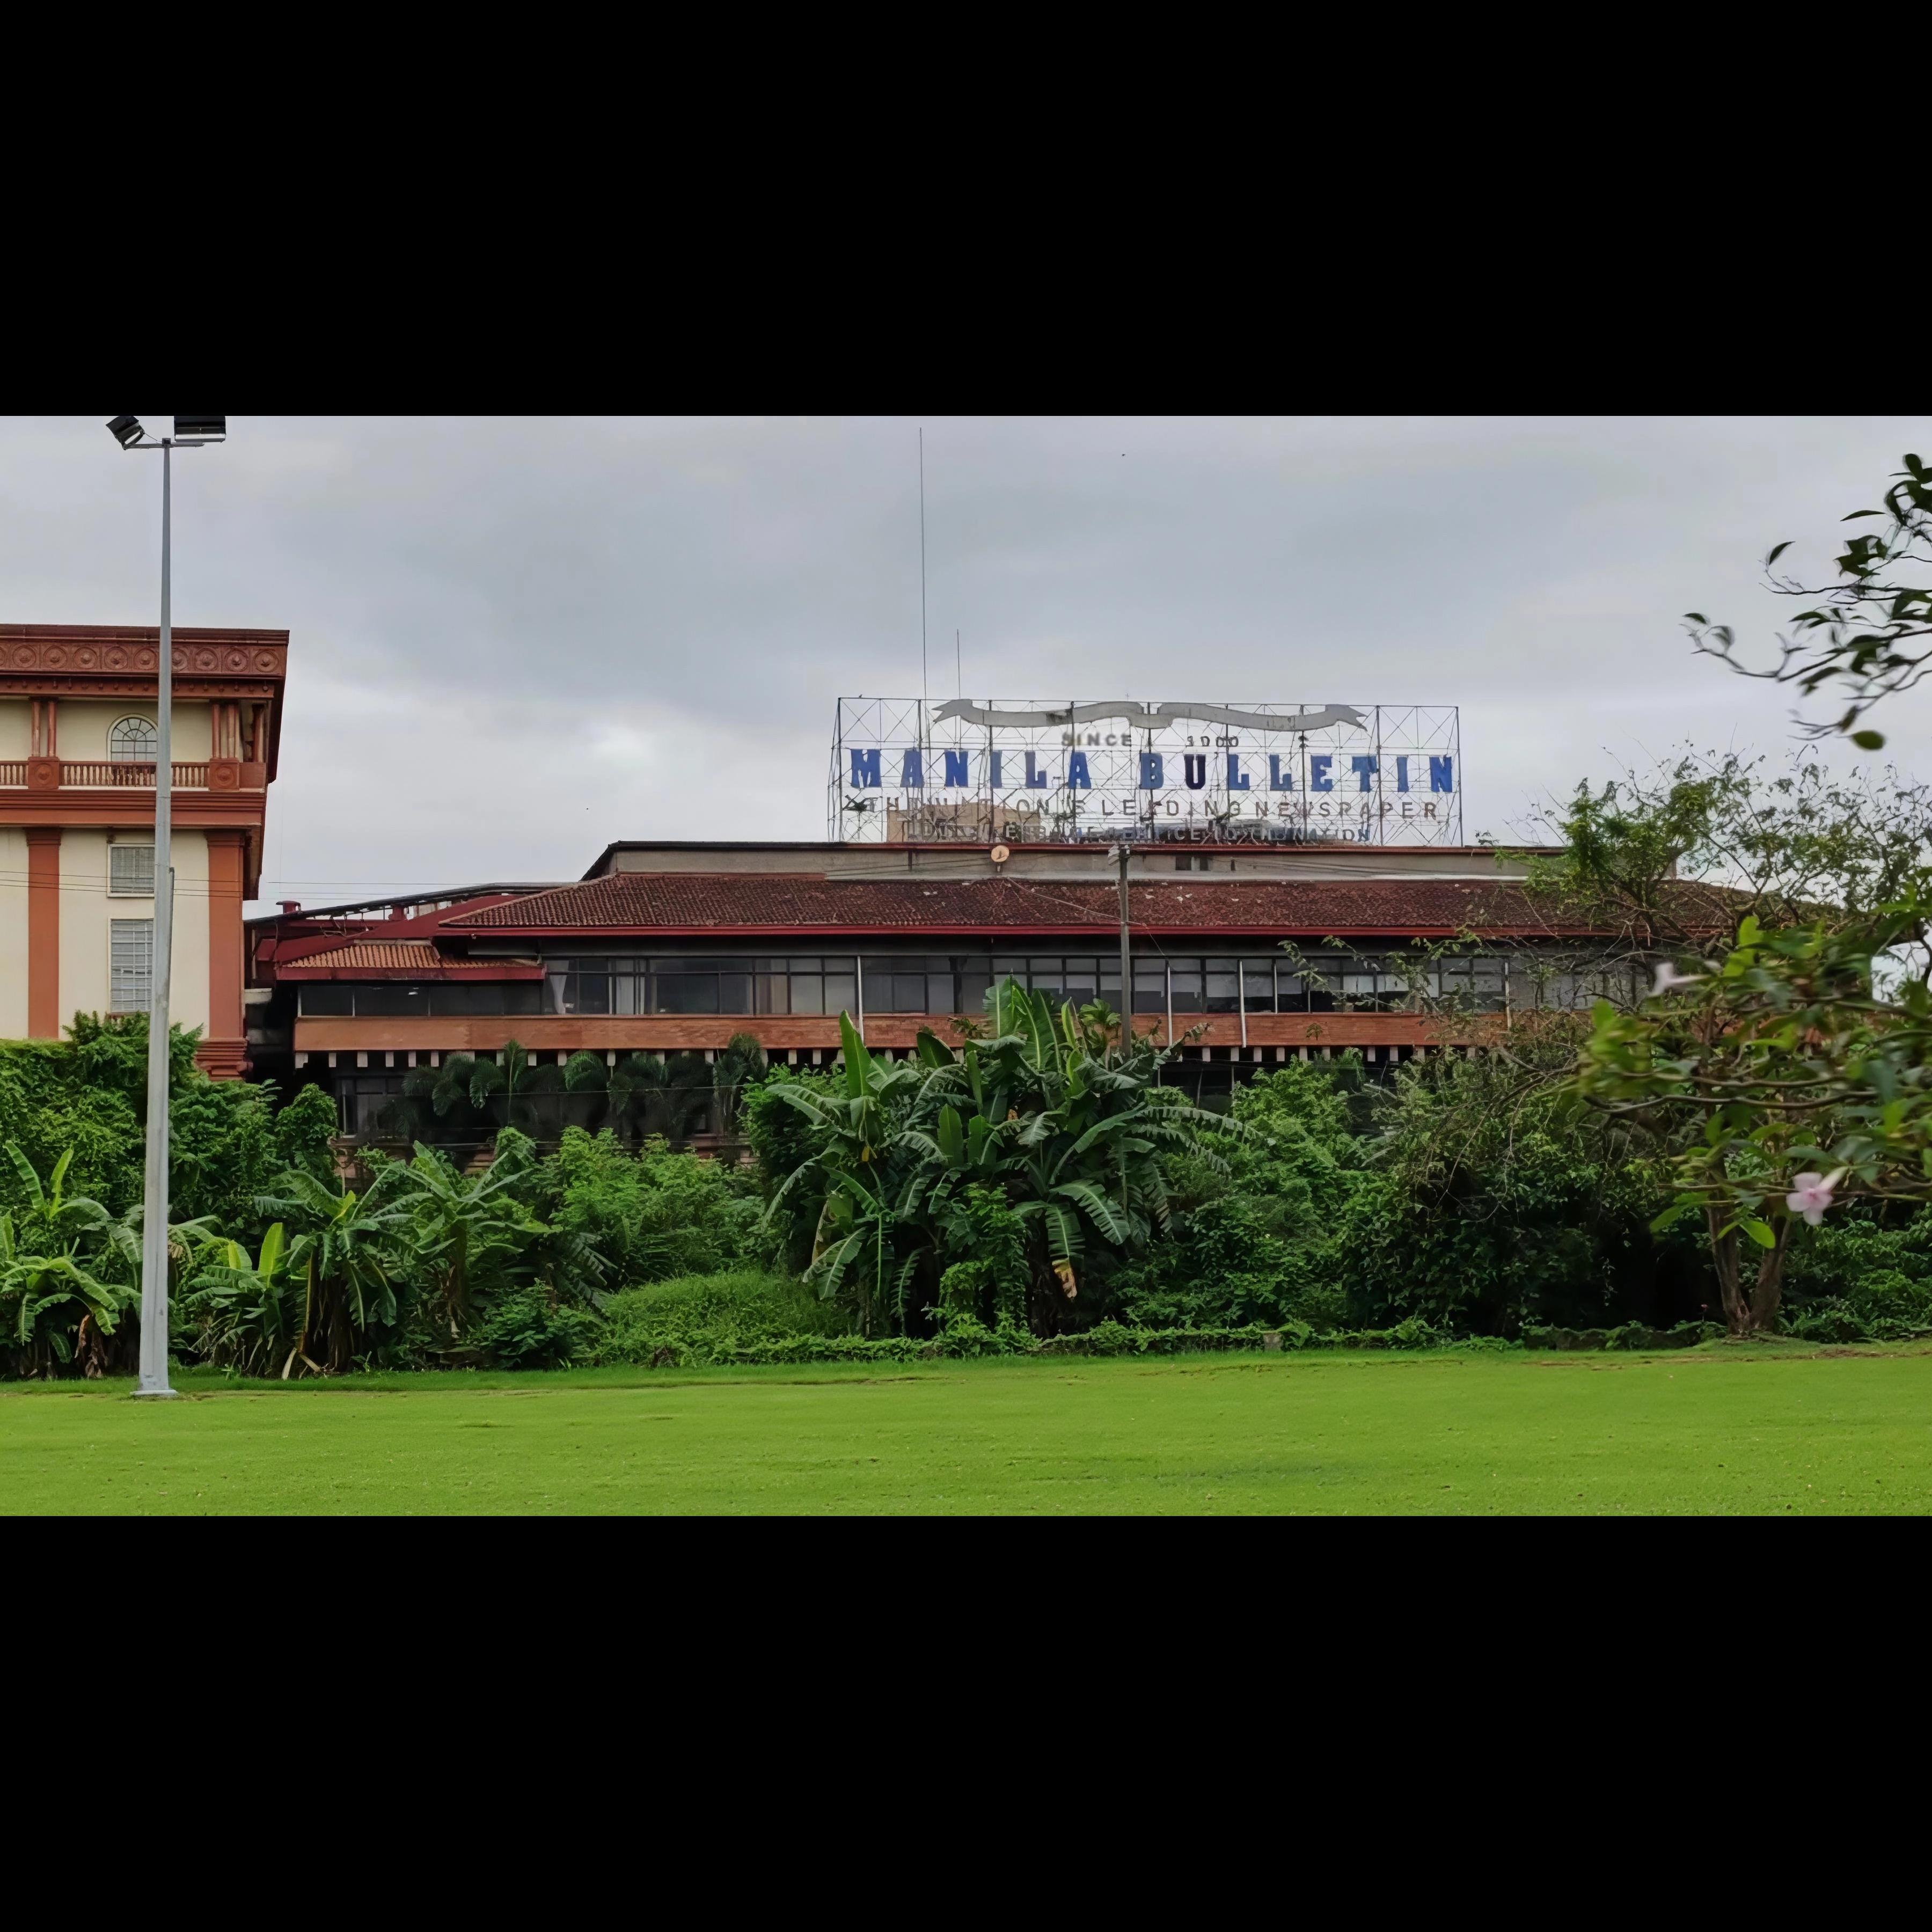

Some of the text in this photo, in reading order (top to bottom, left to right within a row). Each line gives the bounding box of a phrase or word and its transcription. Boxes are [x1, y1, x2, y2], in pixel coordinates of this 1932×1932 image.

[1062, 732, 1132, 747] SINCE
[851, 748, 1453, 793] MANILA BULLETIN
[1102, 799, 1241, 817] LEDING
